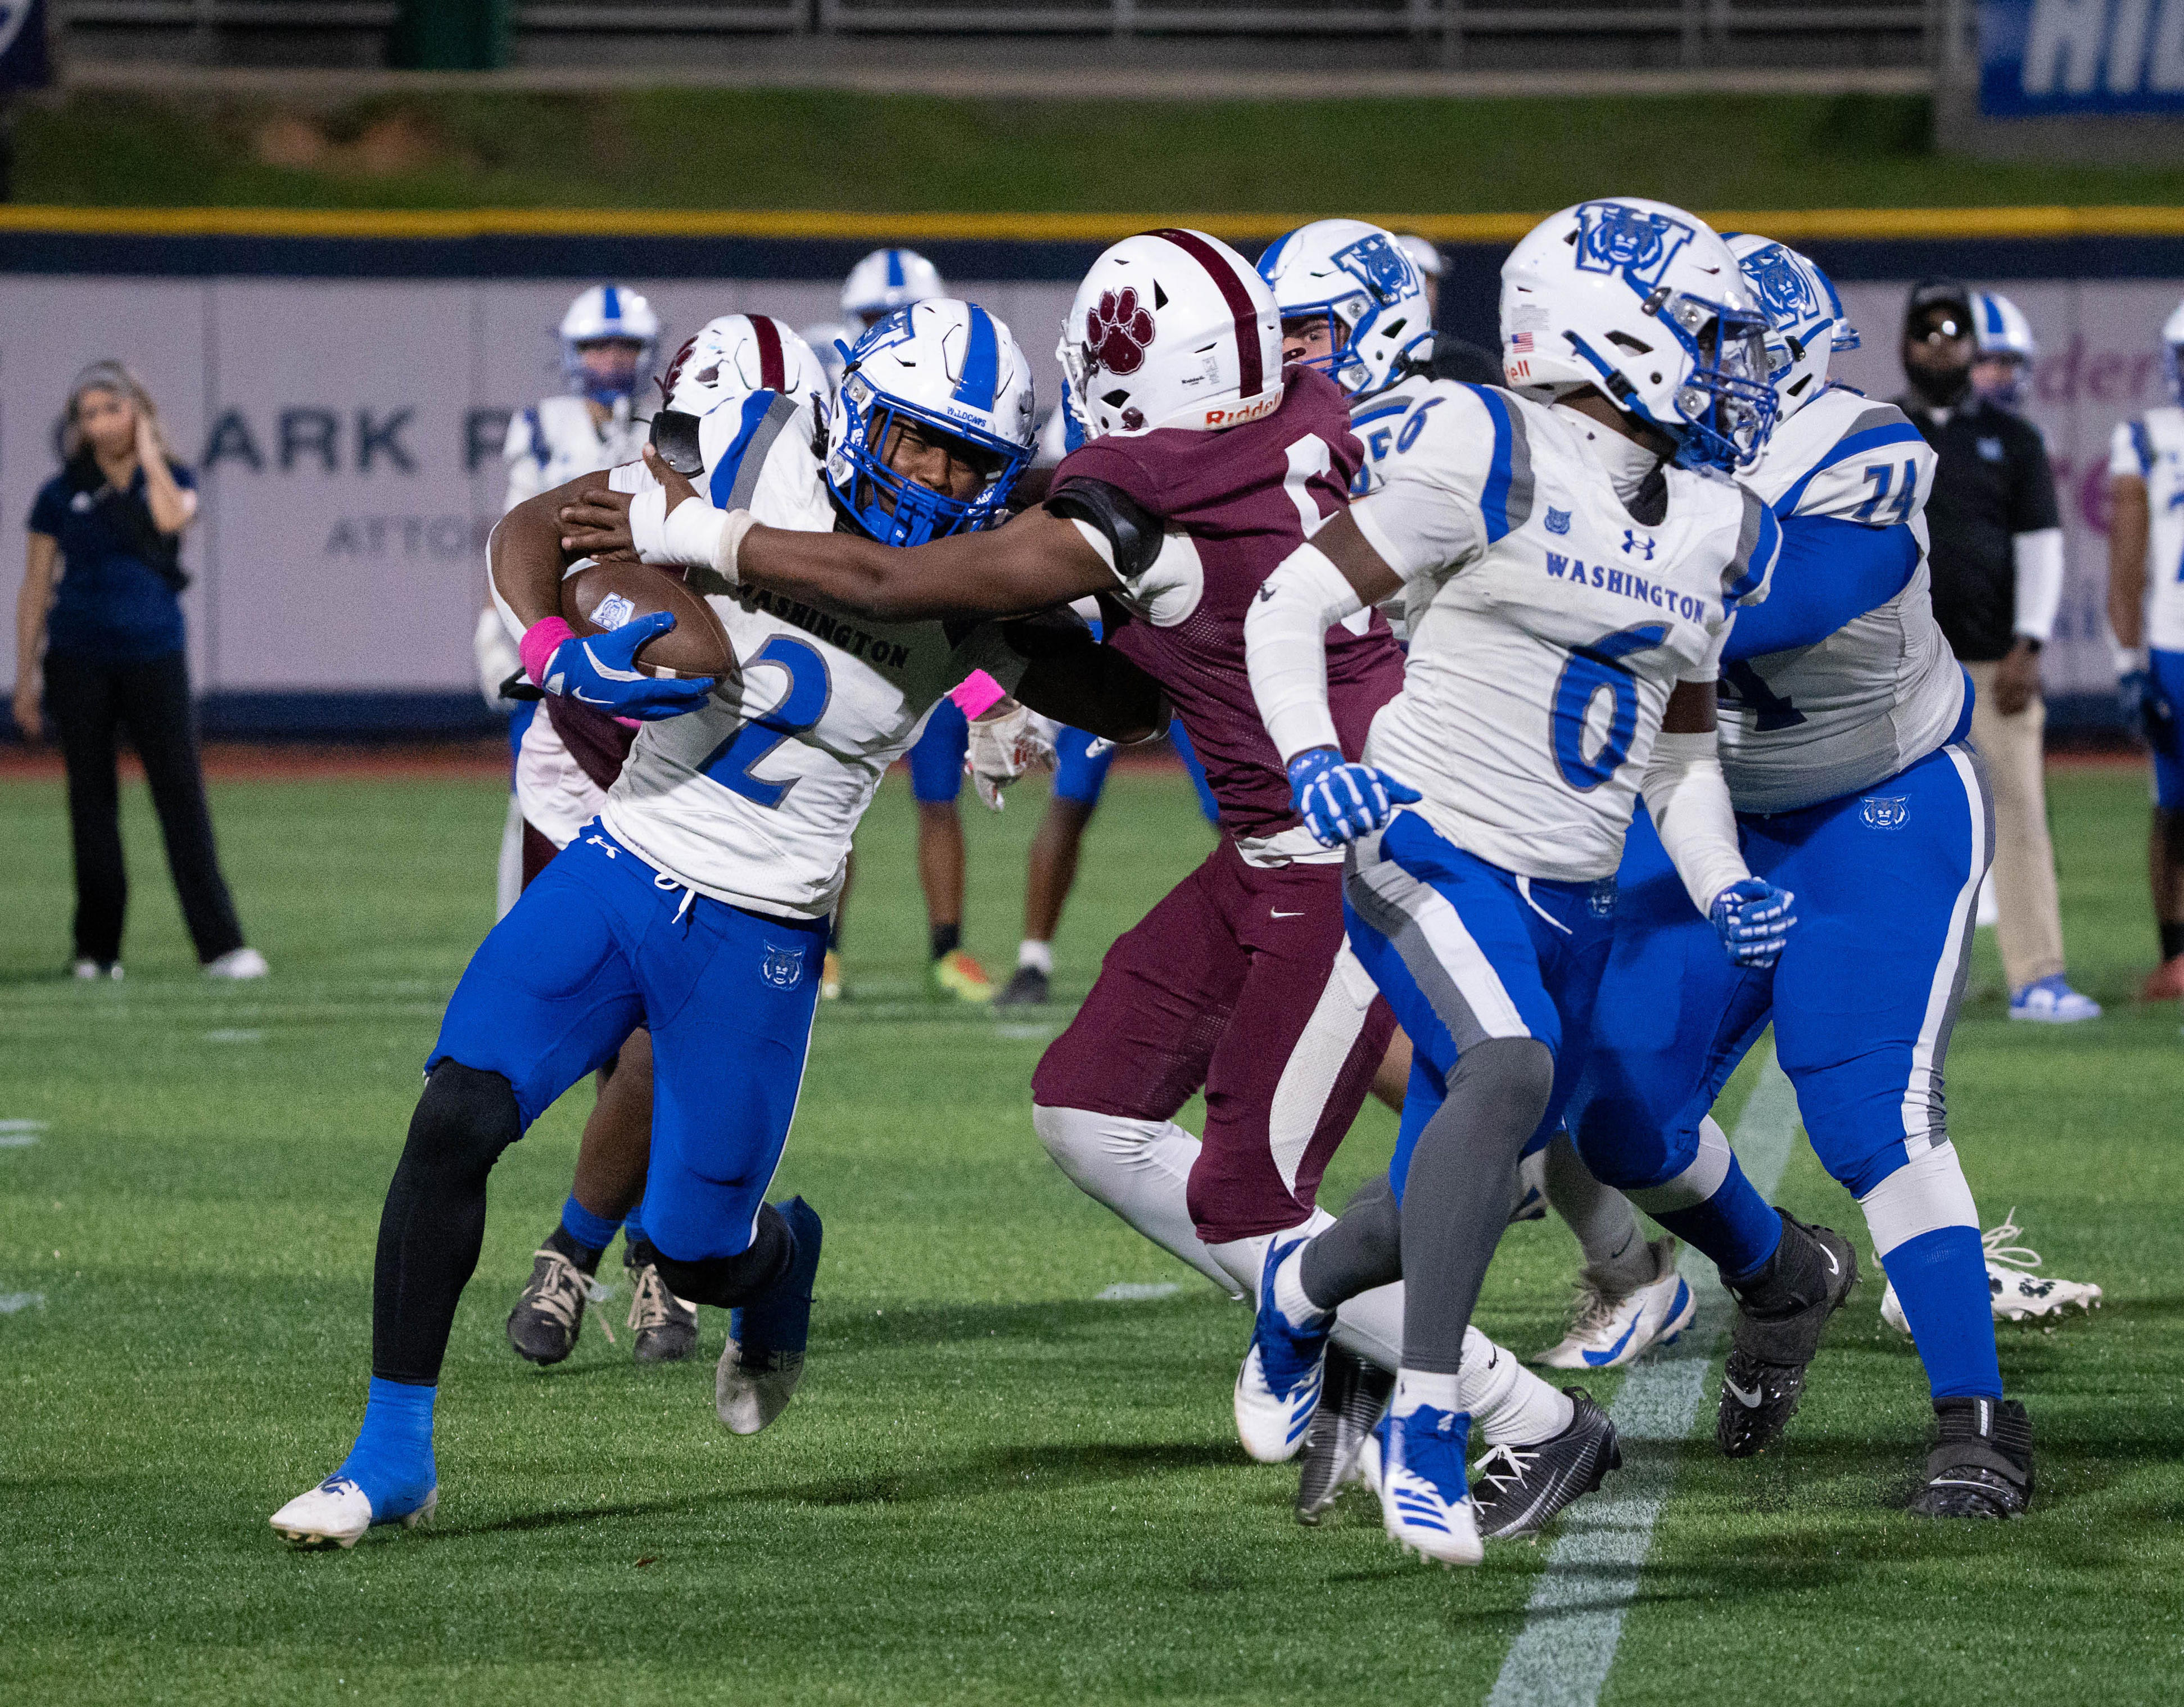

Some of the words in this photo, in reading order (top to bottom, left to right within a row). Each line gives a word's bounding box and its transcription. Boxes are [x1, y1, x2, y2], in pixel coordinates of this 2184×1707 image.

[1851, 458, 1918, 525] 74
[1546, 551, 1705, 624] WASHINGTON
[694, 633, 833, 810] 2
[1548, 619, 1675, 794] 6
